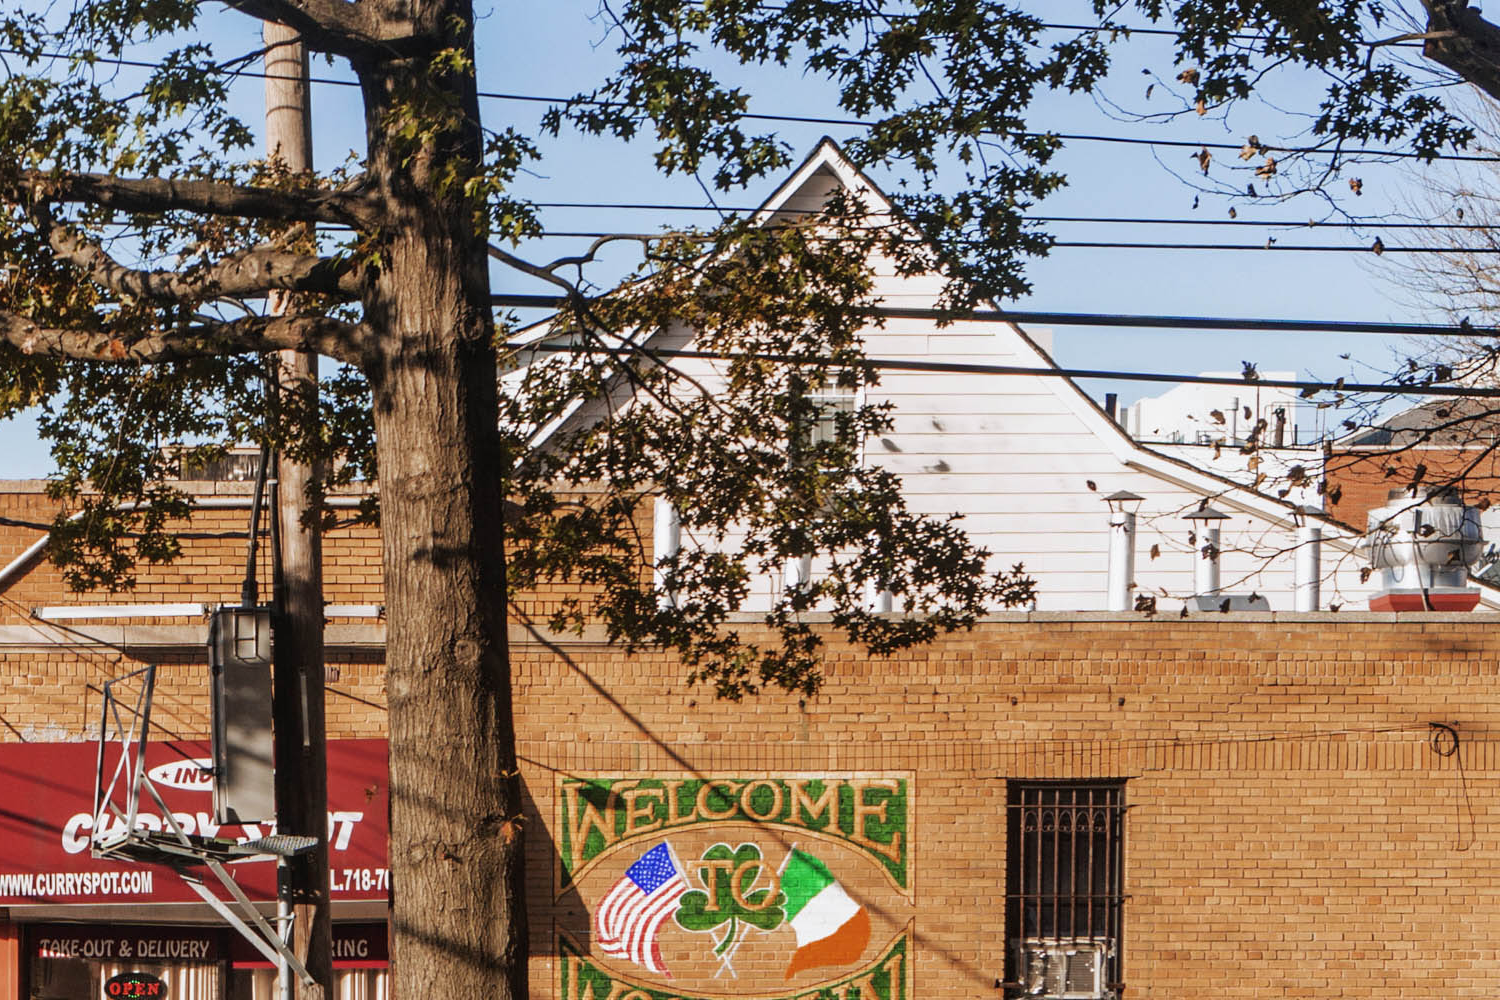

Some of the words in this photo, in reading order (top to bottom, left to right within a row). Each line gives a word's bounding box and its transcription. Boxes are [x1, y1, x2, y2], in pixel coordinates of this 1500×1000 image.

[563, 778, 902, 872] WELCOME
[687, 859, 781, 911] TO
[39, 938, 115, 958] TAKE-OUT
[118, 938, 133, 958] &
[137, 939, 210, 959] DELIVERY
[108, 982, 160, 996] OPEN
